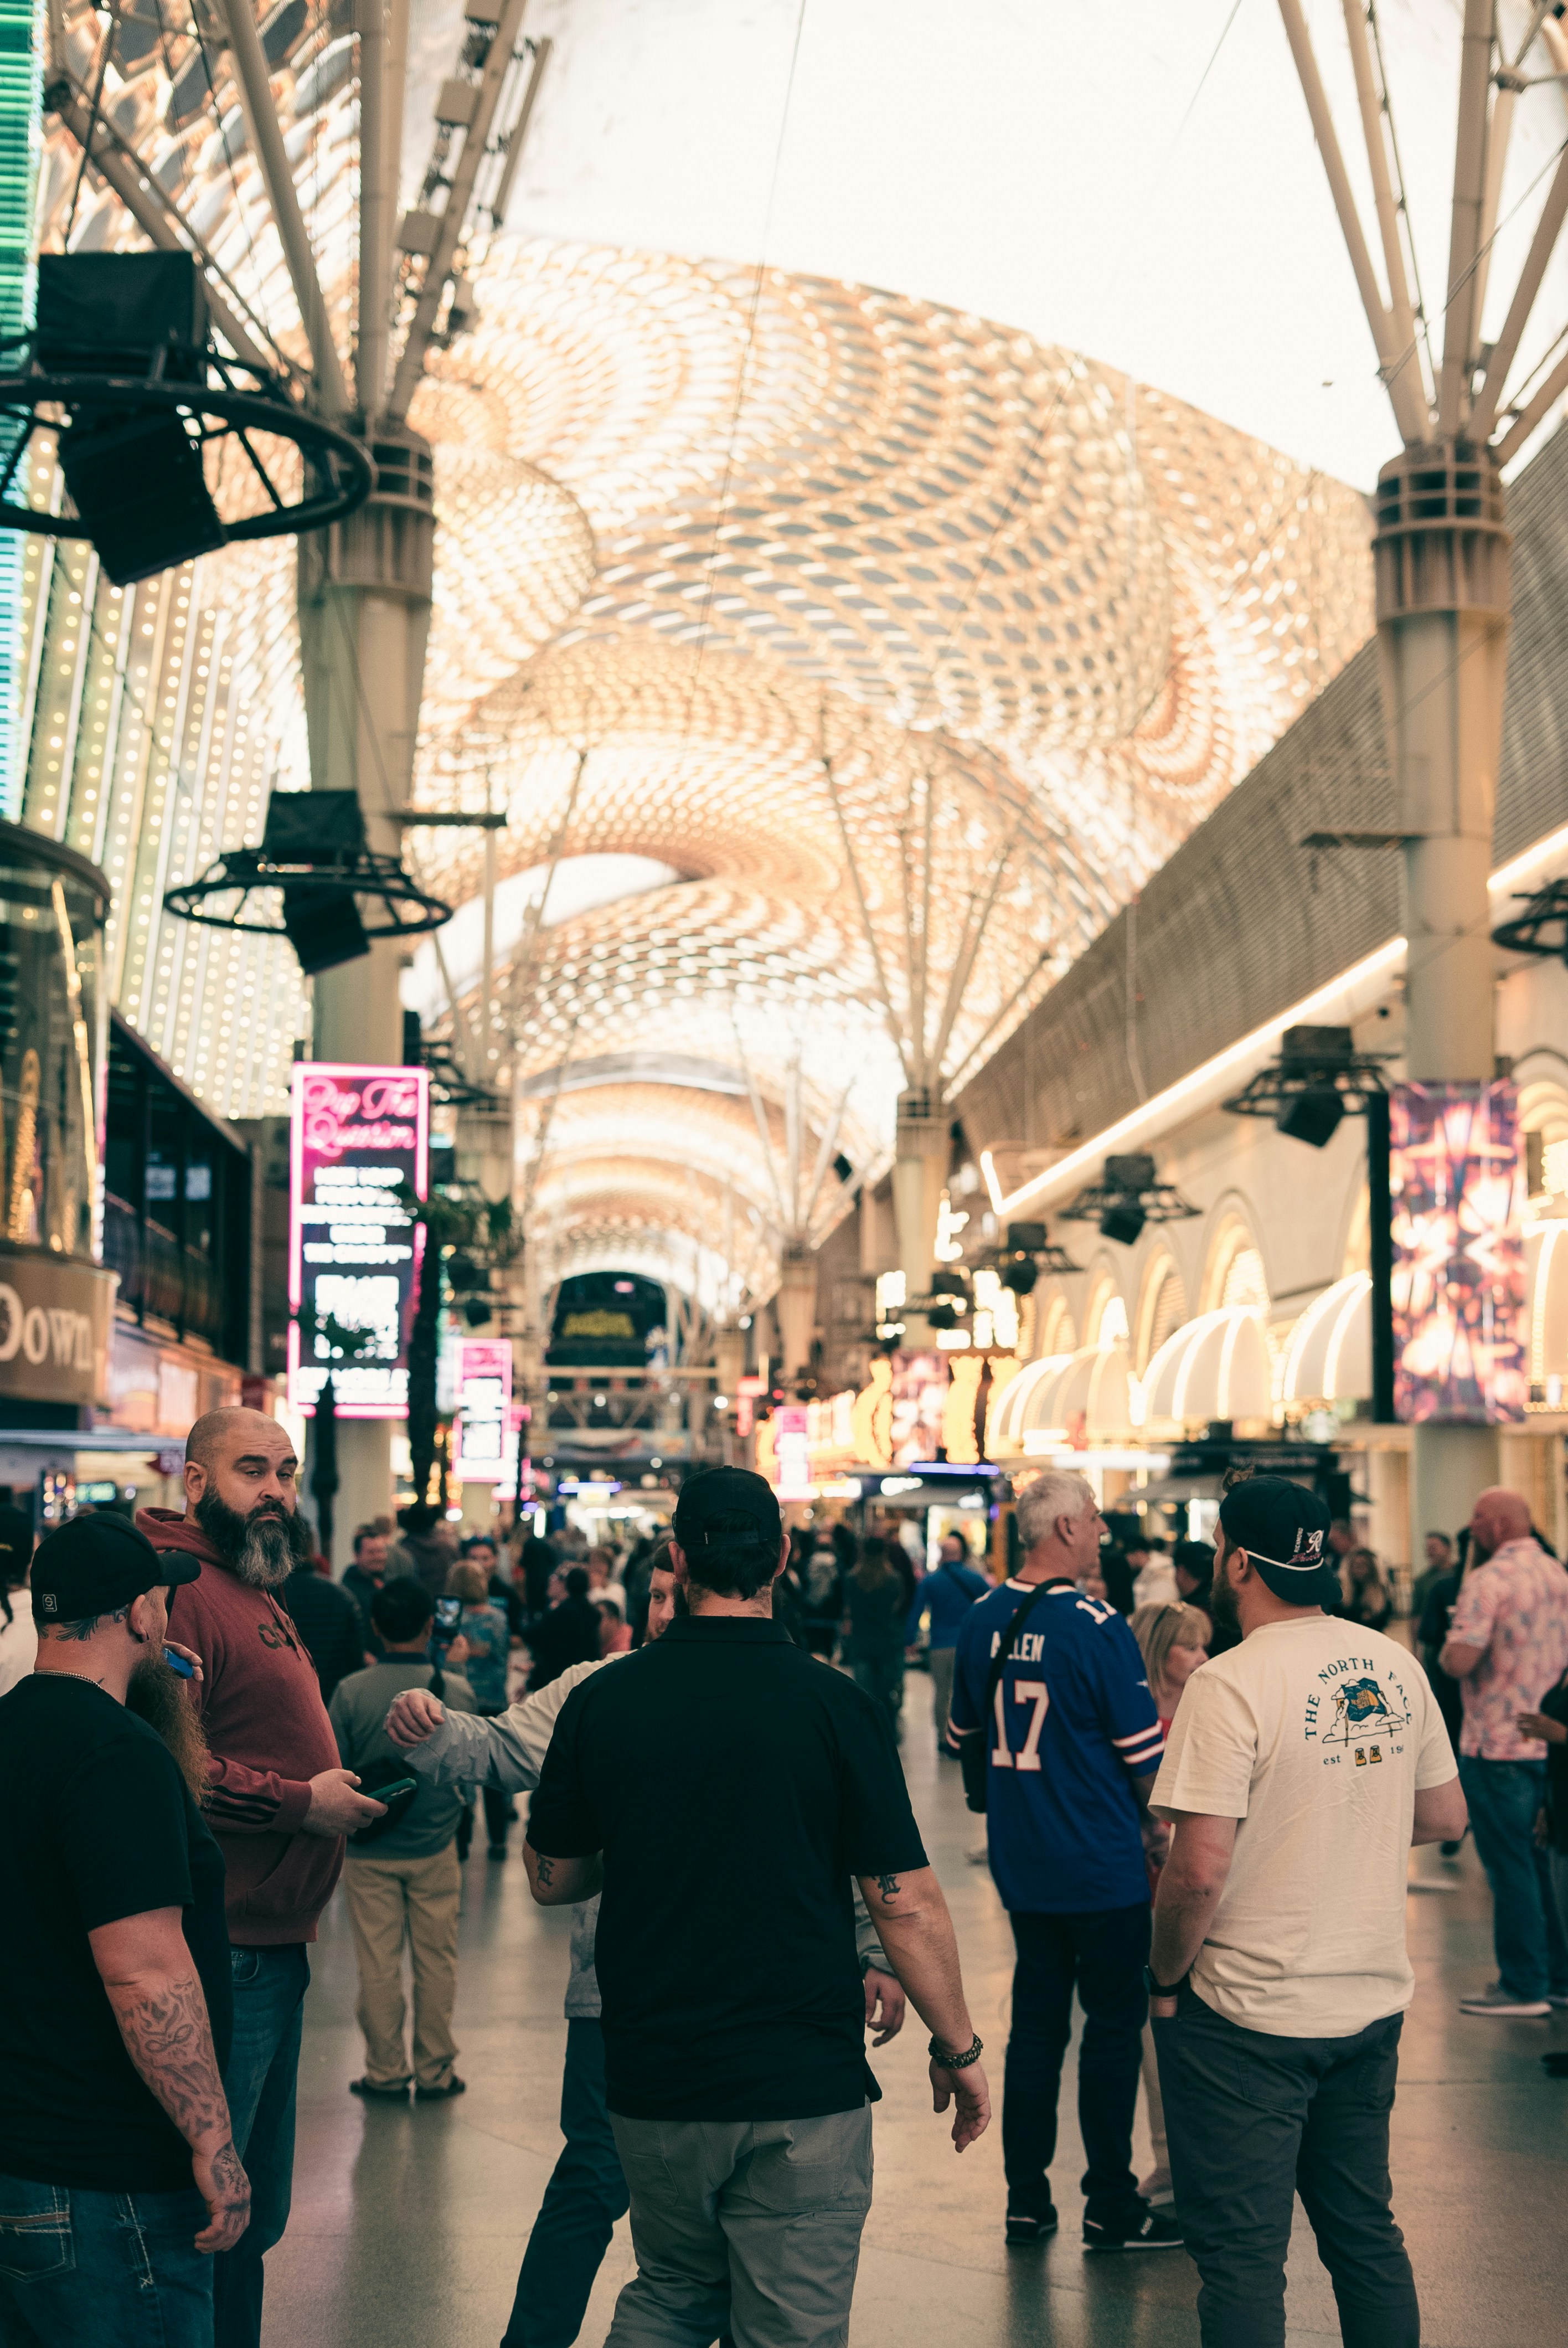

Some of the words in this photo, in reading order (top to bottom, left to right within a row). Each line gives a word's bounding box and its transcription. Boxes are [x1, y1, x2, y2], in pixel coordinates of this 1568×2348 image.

[992, 1678, 1050, 1772] 17
[1304, 1693, 1321, 1741] THE
[1317, 1657, 1374, 1685] NORTH
[1323, 1754, 1342, 1765] est
